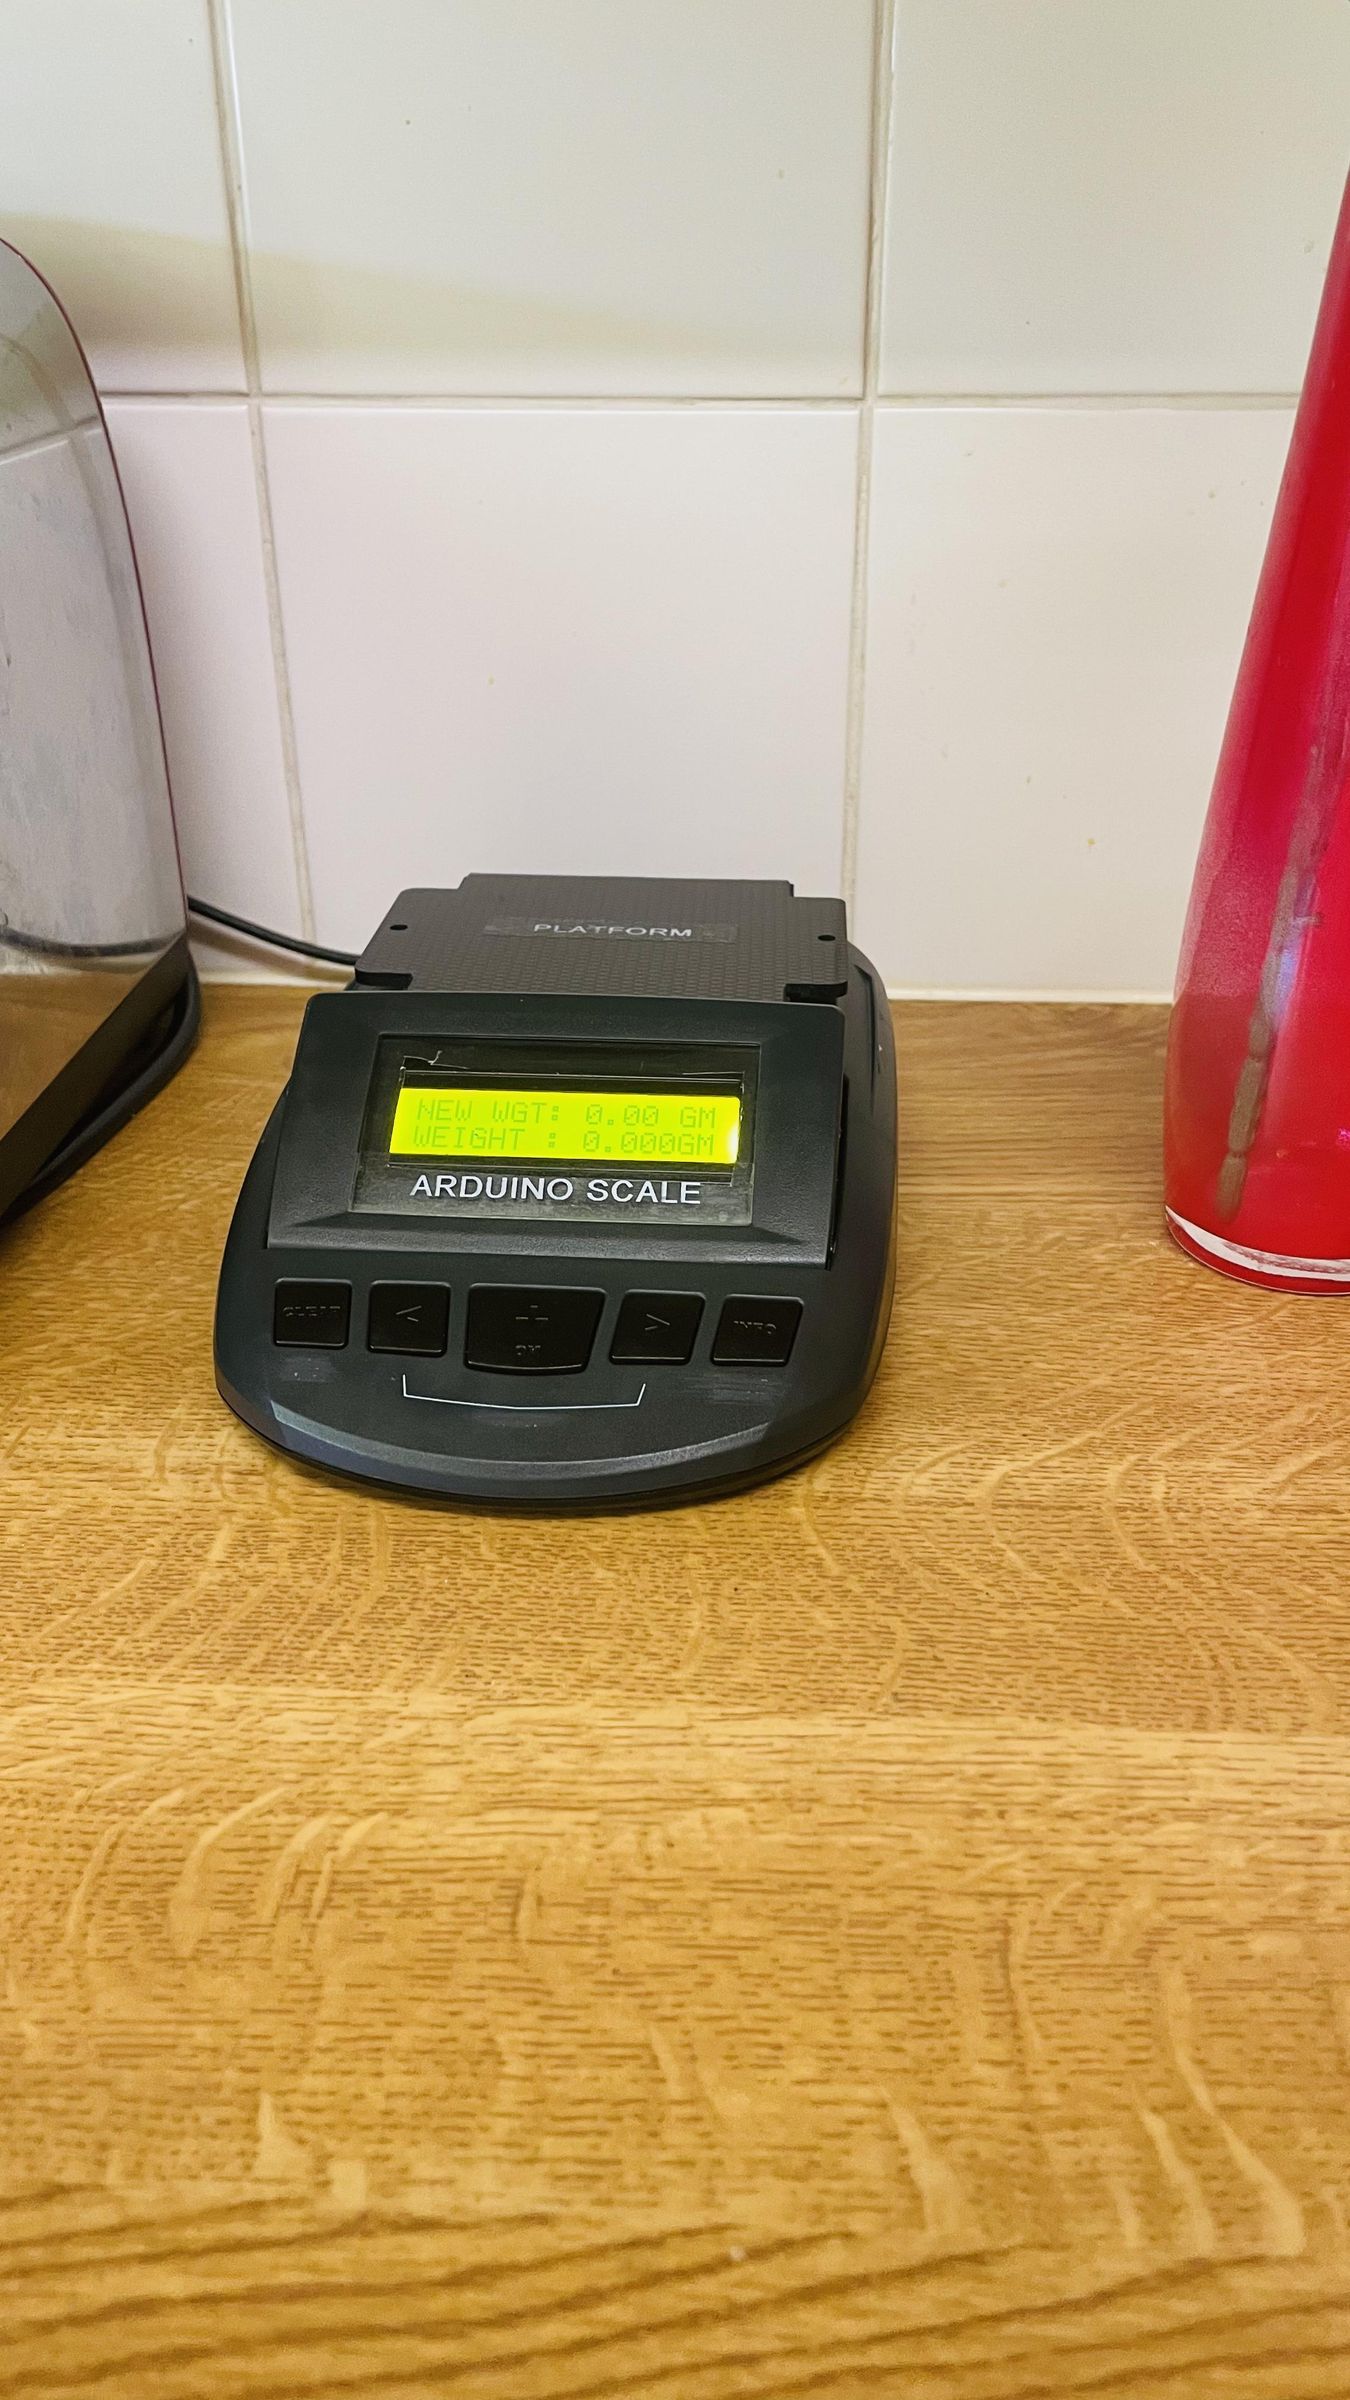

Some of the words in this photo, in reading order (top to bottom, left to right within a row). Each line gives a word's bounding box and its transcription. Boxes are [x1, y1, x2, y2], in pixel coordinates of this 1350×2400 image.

[533, 923, 693, 937] PLATFORM
[416, 1098, 473, 1122] NEW
[491, 1101, 560, 1125] WGT:
[585, 1103, 659, 1127] 0.00
[679, 1107, 717, 1129] GM
[412, 1126, 526, 1150] WEIGHT
[582, 1131, 716, 1156] 0.000GM
[410, 1174, 573, 1201] ARDUINO
[586, 1178, 701, 1204] SCALE
